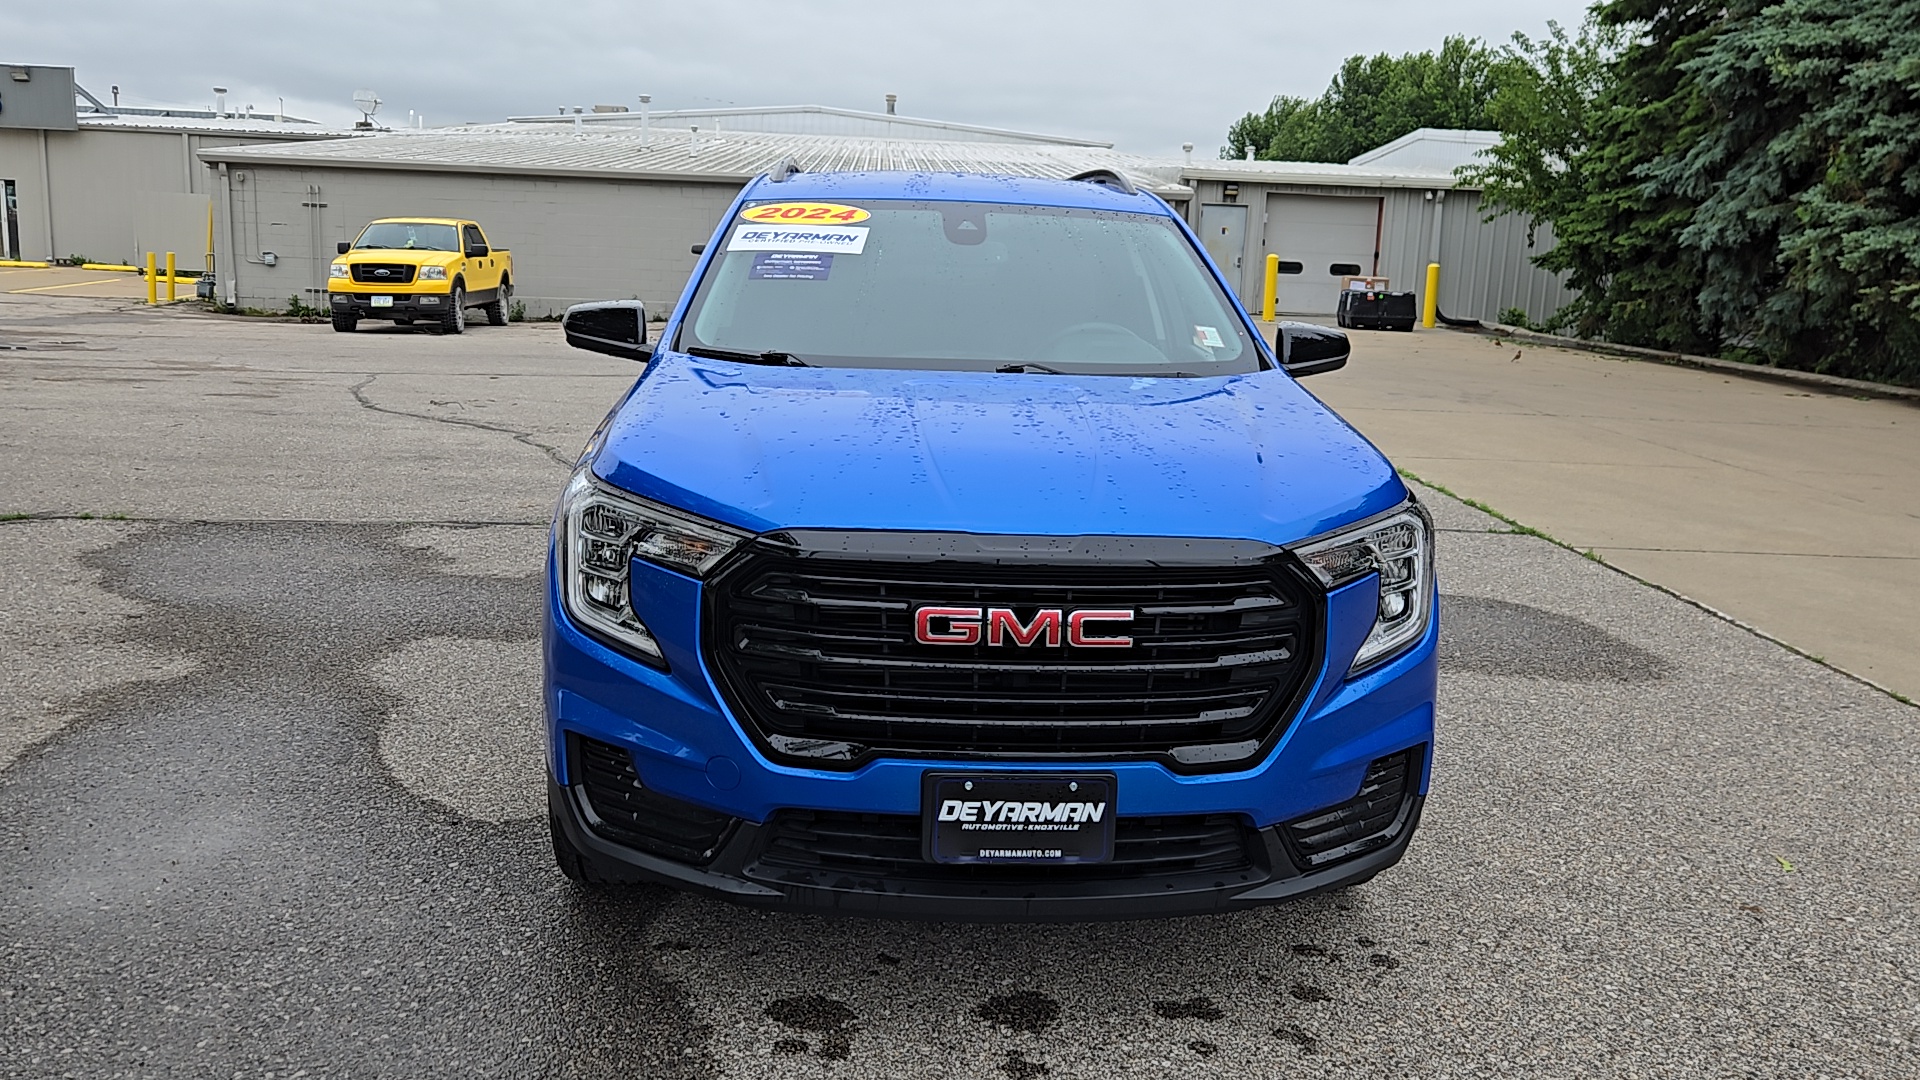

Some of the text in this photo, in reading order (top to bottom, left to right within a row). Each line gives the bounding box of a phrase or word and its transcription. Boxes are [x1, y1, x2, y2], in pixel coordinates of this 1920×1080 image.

[752, 207, 859, 221] 2024
[741, 231, 860, 243] DEYARMAN
[914, 606, 1134, 648] GMC
[938, 799, 1107, 823] DEYARMAN
[979, 849, 1062, 858] DEYARMANAUTO.COM
